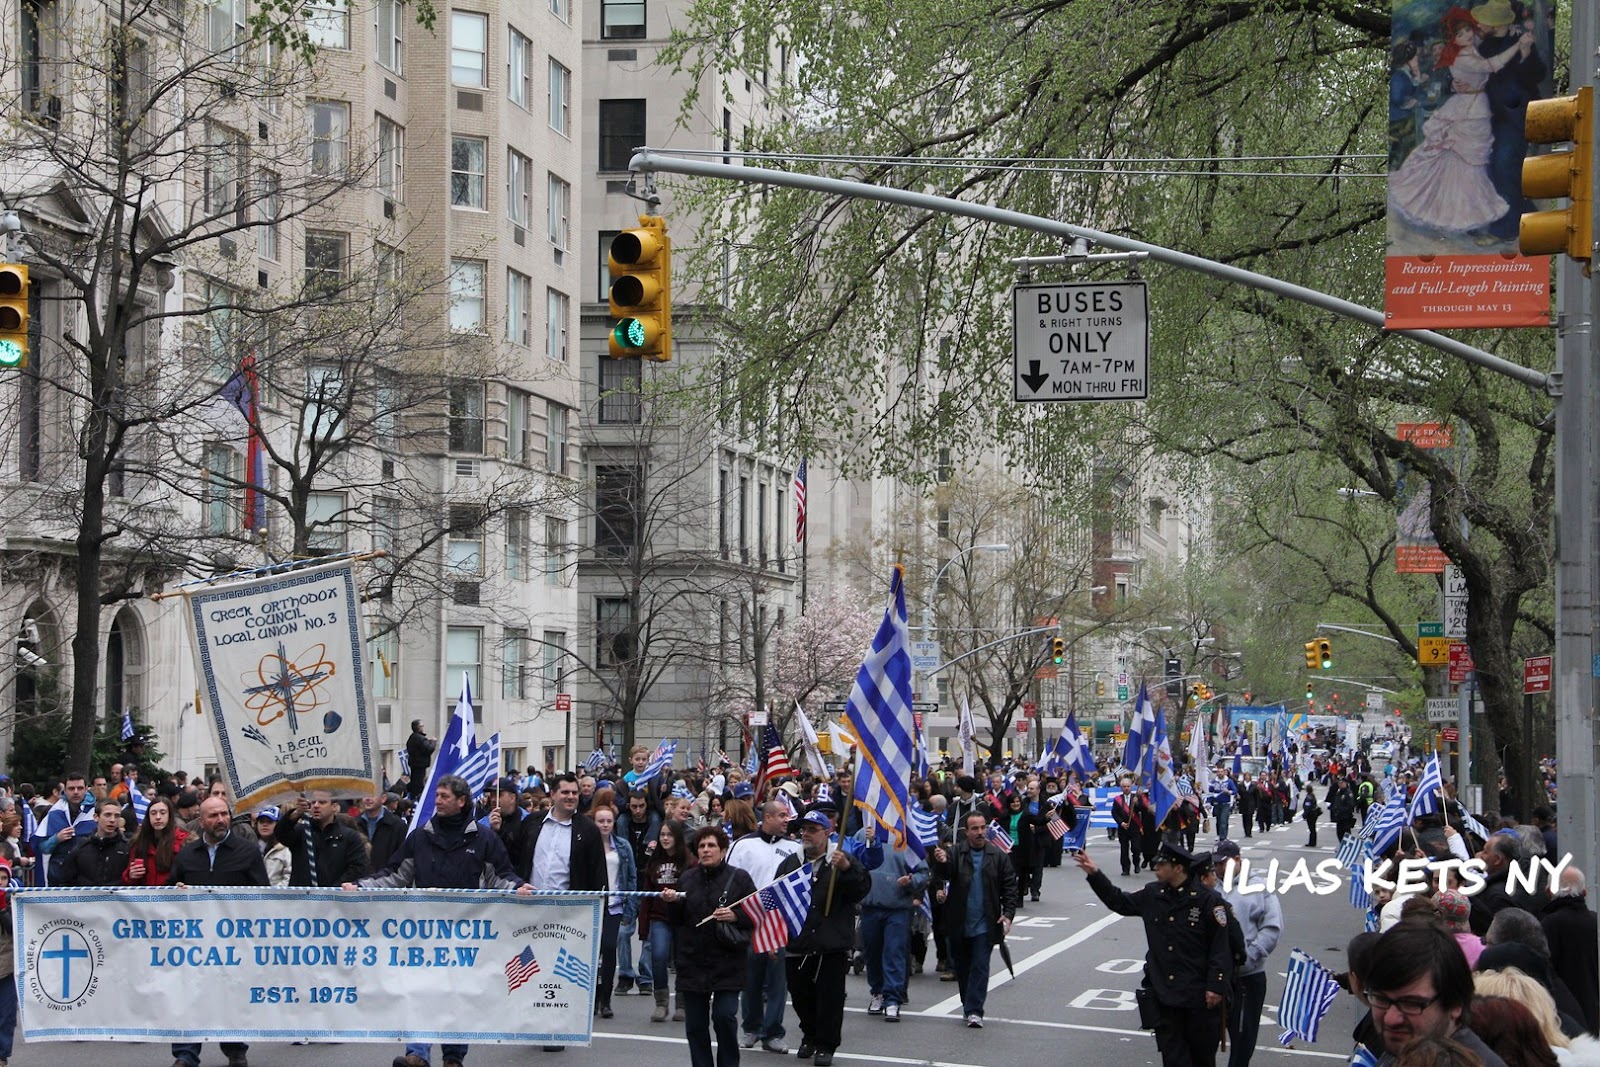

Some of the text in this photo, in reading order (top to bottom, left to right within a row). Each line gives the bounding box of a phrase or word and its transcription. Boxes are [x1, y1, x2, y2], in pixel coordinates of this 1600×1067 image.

[1402, 262, 1533, 276] Renoir, Impressionism,
[1392, 280, 1544, 296] and Full-Length Painting
[1038, 290, 1122, 314] BUSES
[1502, 304, 1512, 313] 13
[1040, 317, 1122, 328] & RIGHT TURNS
[1049, 332, 1112, 354] ONLY
[1060, 359, 1134, 374] 7AM-7PM
[1052, 379, 1142, 393] MON THRU FRI
[210, 587, 338, 623] GREEK ORTHODOX
[245, 608, 306, 628] COUNCIL
[214, 612, 337, 646] LOCAL UNION NO. 3
[275, 747, 327, 765] AFL-CIO
[112, 918, 499, 940] GREEK ORTHODOX COUNCIL
[512, 924, 587, 940] GREEK ORTHODOX
[532, 931, 567, 940] COUNCIL
[27, 919, 104, 970] GREEK ORTHODOX COUNCIL
[150, 946, 242, 966] LOCAL
[388, 947, 479, 966] I.B.E.W
[30, 977, 44, 1003] LOCAL
[47, 1003, 72, 1011] UNION
[88, 976, 98, 997] IBEW
[250, 986, 358, 1004] EST. 1975
[544, 990, 555, 999] 3
